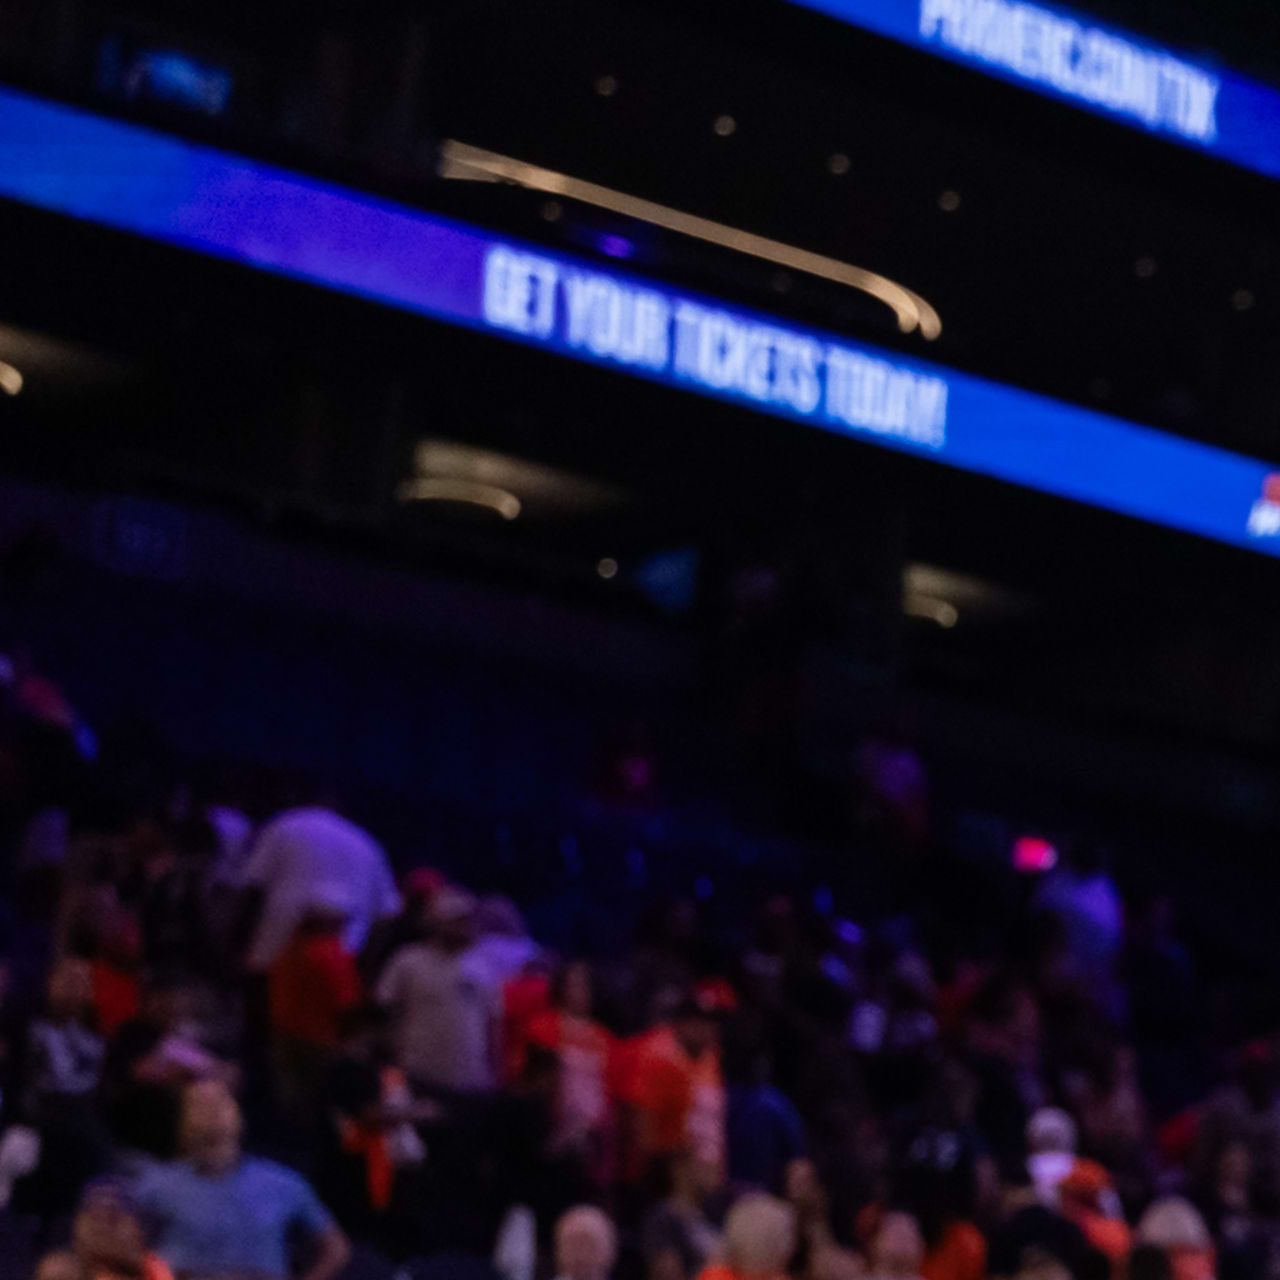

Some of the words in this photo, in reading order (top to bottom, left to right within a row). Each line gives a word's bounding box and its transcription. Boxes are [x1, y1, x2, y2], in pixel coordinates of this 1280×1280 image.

[484, 244, 558, 341] GET
[565, 274, 670, 371] YOUR
[674, 300, 820, 415] TICKETS
